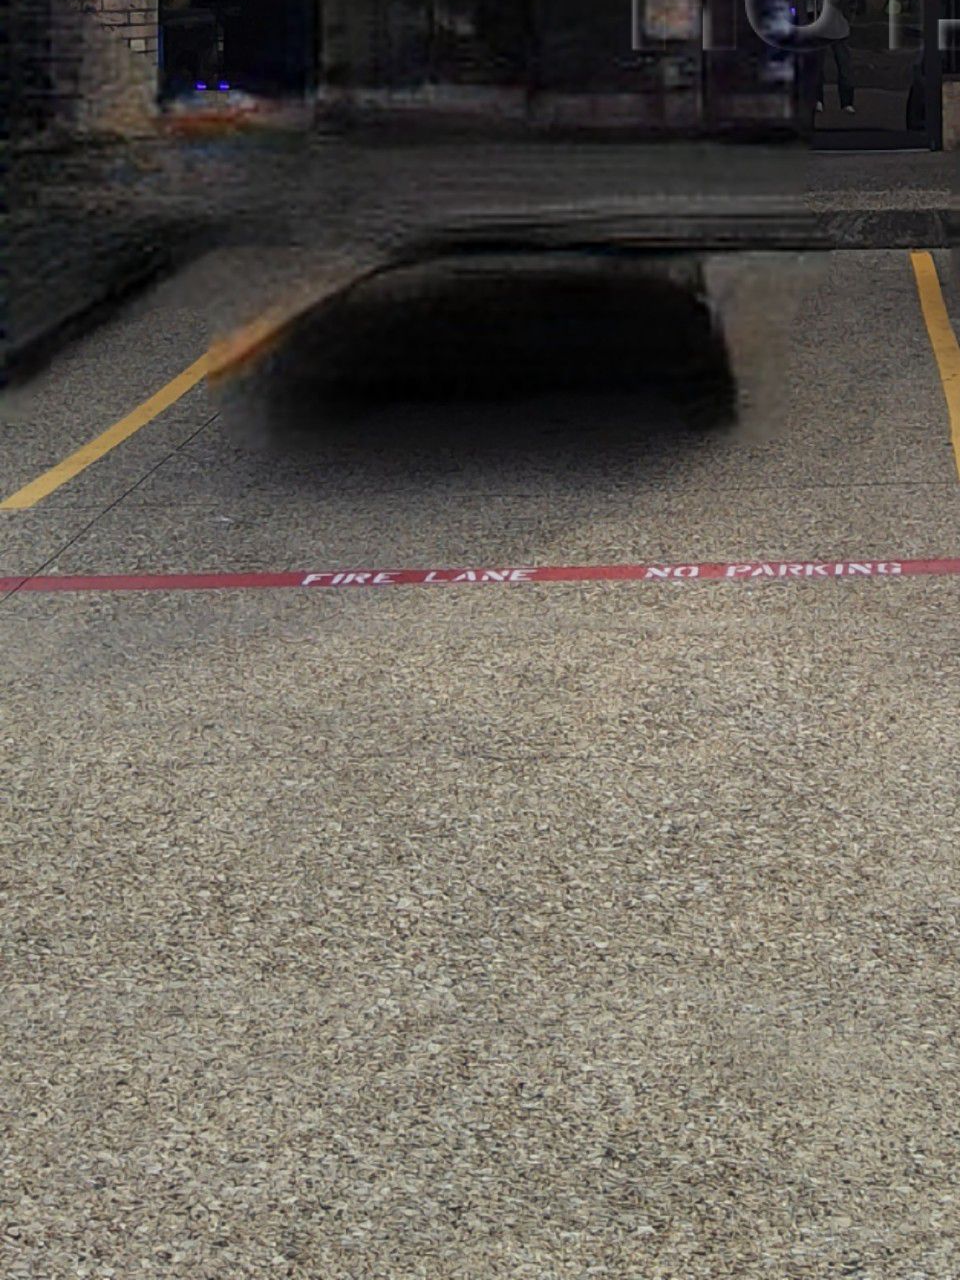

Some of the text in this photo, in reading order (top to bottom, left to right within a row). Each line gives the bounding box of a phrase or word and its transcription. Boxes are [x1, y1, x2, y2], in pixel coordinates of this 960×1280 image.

[301, 563, 902, 586] FIRE LANE NO PARKING
